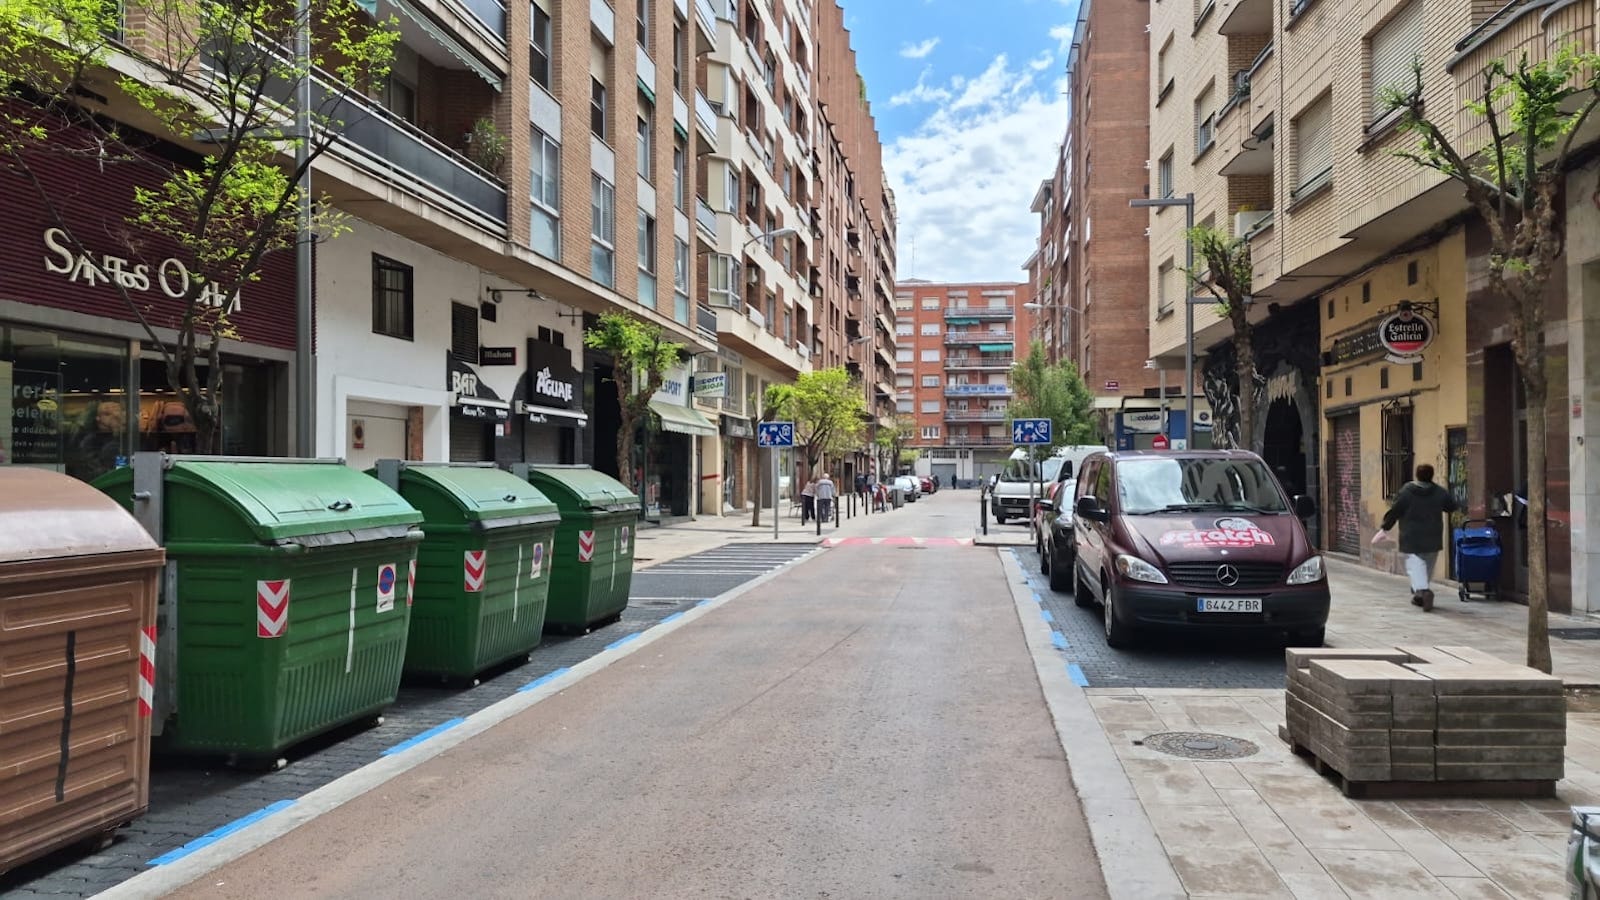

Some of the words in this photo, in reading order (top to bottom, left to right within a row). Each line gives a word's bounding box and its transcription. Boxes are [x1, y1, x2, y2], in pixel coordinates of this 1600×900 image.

[1388, 323, 1424, 332] Estrella
[1390, 331, 1422, 341] Galicia
[452, 370, 478, 397] BAR
[536, 370, 573, 402] AGUAJE
[1206, 600, 1235, 611] 6442
[1237, 600, 1259, 611] FBR
